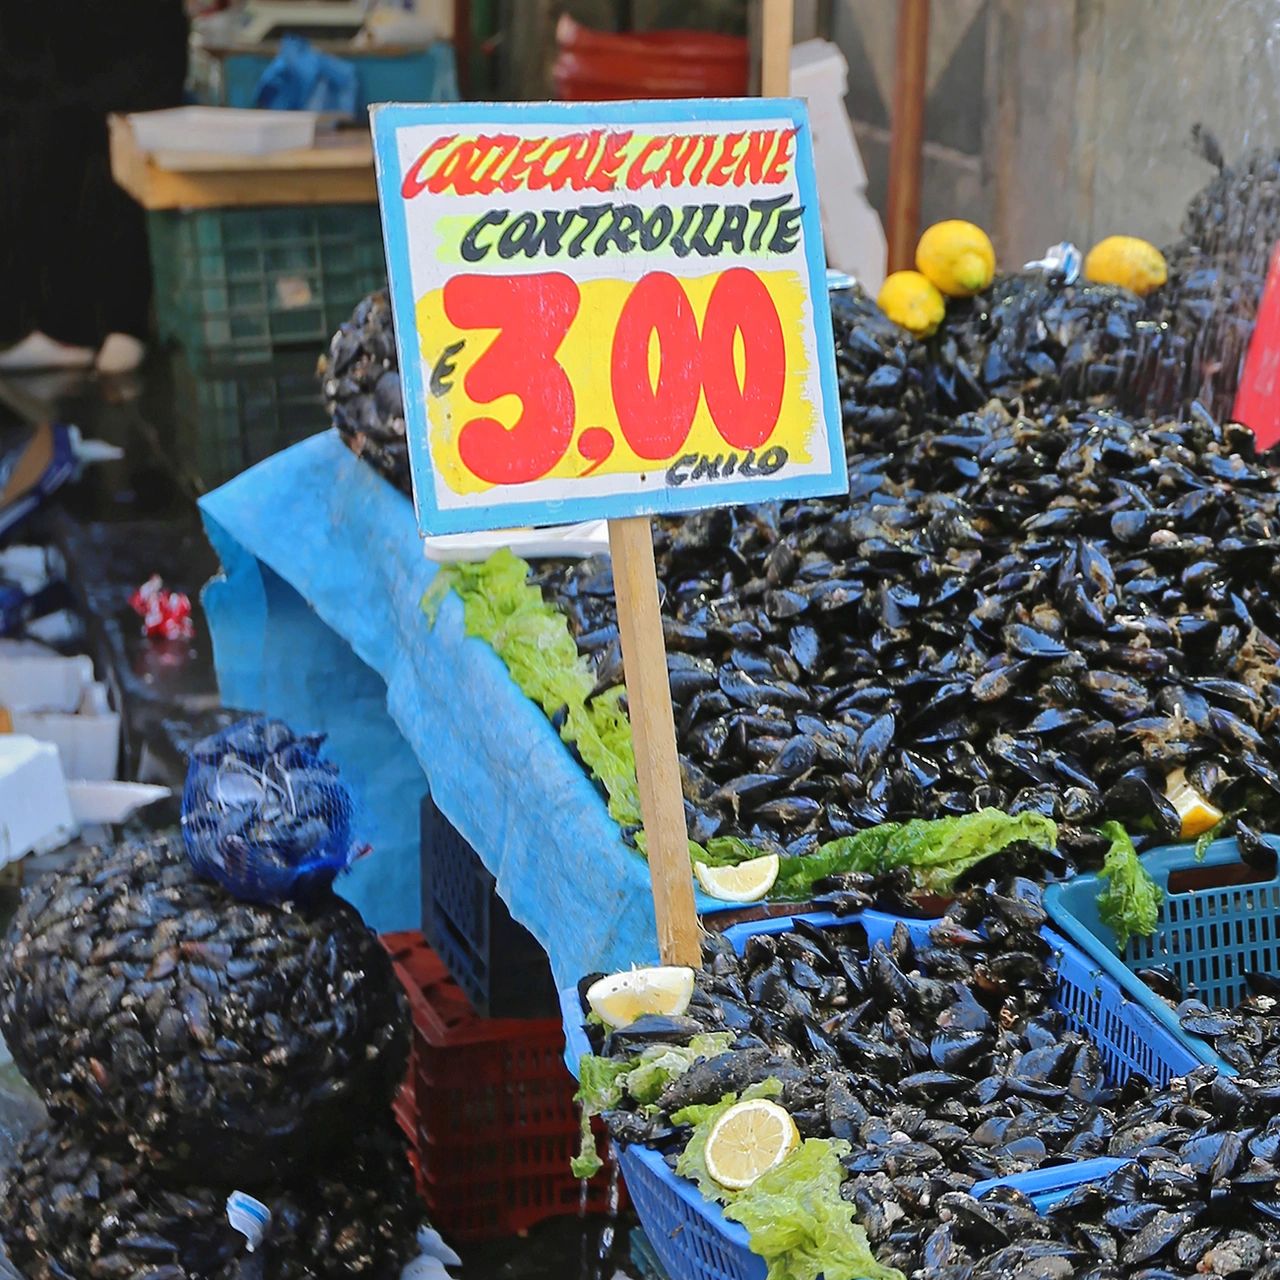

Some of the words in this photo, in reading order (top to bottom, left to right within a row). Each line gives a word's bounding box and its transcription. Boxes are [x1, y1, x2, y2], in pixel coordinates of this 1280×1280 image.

[625, 126, 802, 191] CHIENE
[460, 194, 806, 263] CONTROLLATE
[443, 267, 786, 485] 3,00
[665, 445, 788, 486] CHILO
